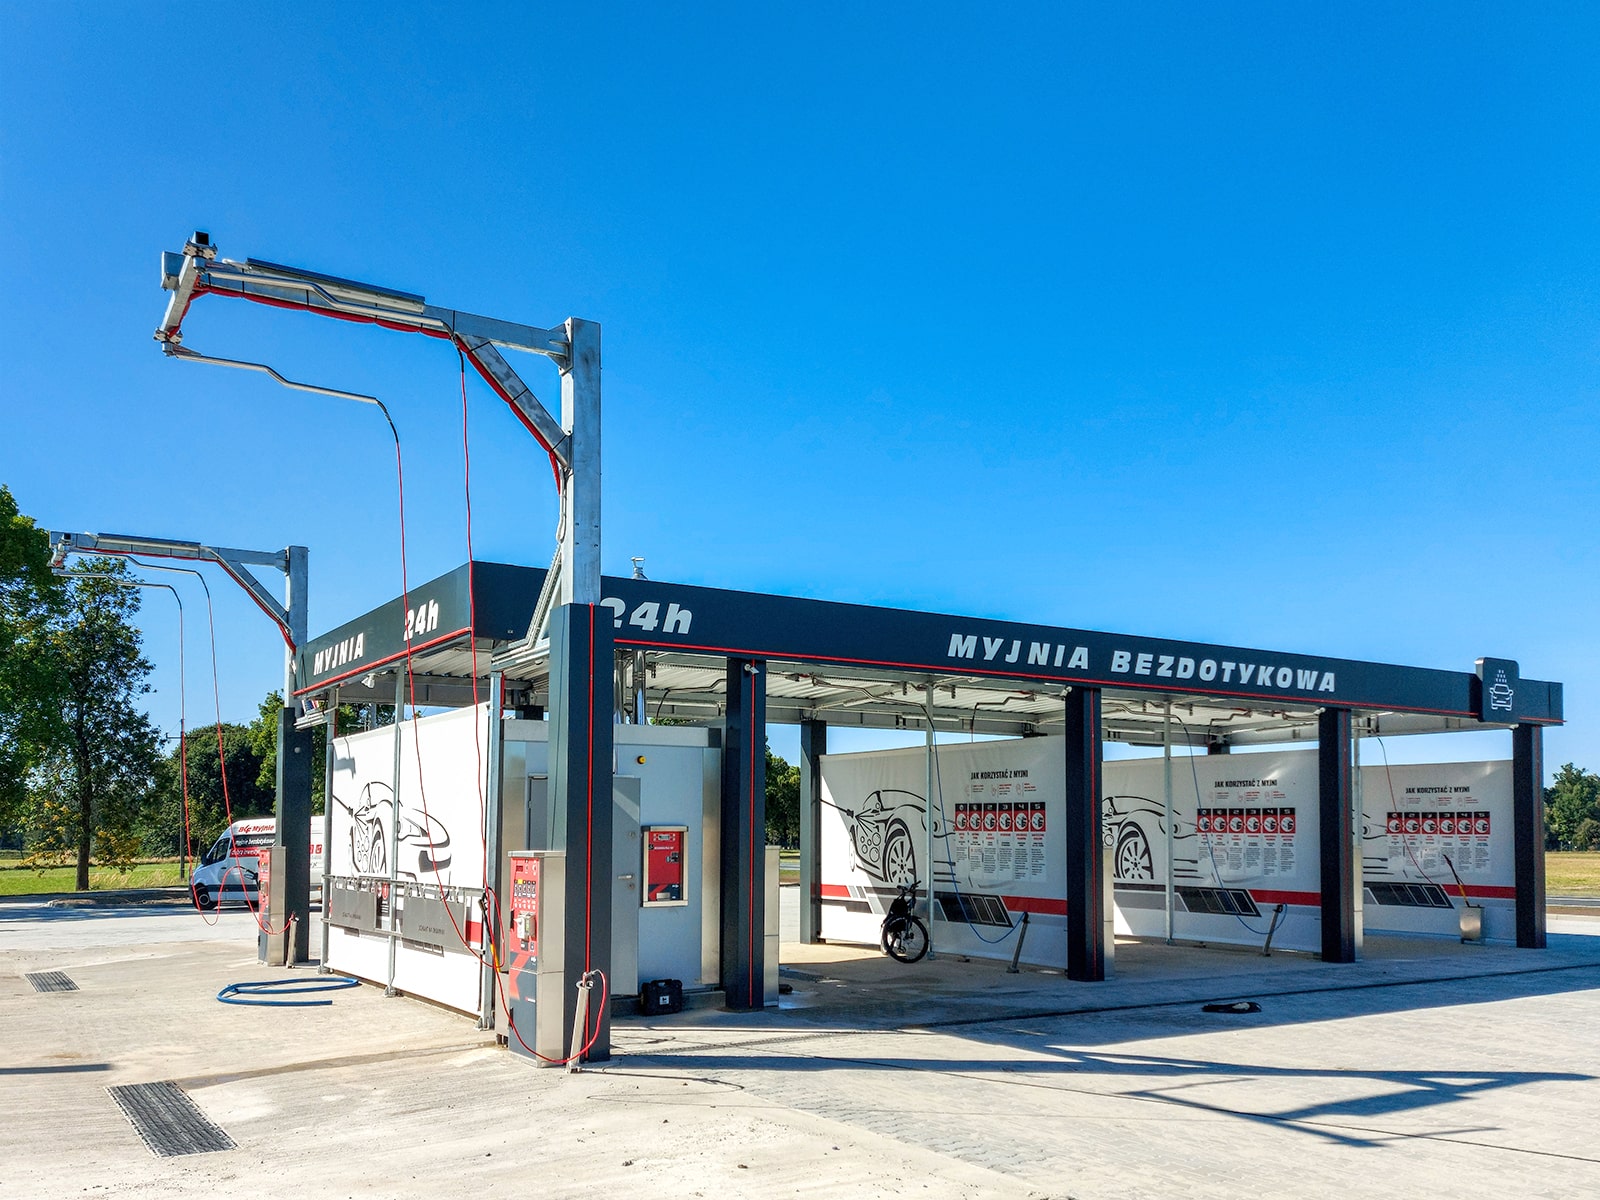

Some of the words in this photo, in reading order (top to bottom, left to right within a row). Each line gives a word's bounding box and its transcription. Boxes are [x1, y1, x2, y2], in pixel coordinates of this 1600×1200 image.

[403, 599, 439, 641] 24h
[313, 632, 364, 676] MYJNIA
[947, 633, 1090, 670] MYJNIA
[1111, 650, 1336, 692] BEZDOTYKOWA
[981, 769, 1008, 779] KORZYSTAĆ
[1226, 778, 1255, 787] KORZYSTAĆ
